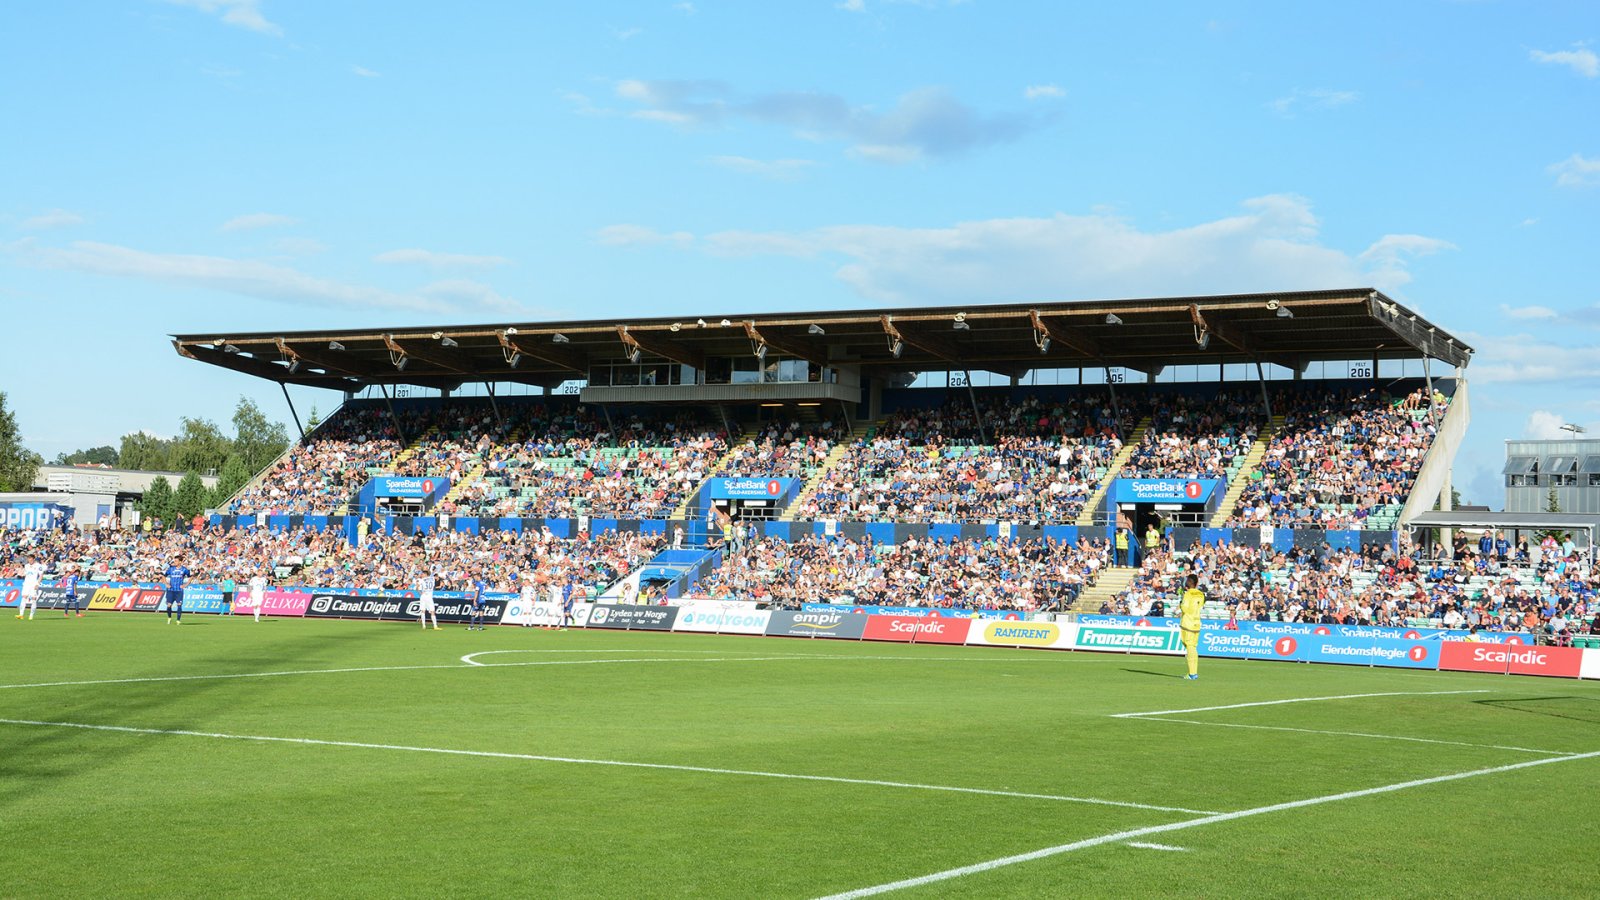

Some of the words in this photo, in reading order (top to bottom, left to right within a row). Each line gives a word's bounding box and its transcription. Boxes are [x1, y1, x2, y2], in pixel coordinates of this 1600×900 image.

[1350, 368, 1371, 378] 206
[951, 377, 967, 387] 204
[564, 386, 579, 394] 202
[386, 479, 421, 489] SpareBank
[724, 480, 766, 490] SpareBank
[1132, 481, 1184, 492] SpareBank
[95, 593, 117, 603] Uno
[264, 597, 306, 609] ELIXIA
[332, 600, 362, 612] Canal
[363, 602, 401, 614] Digital
[610, 610, 632, 618] Lyden
[644, 610, 667, 619] Norge
[696, 613, 766, 627] POLYGON
[793, 613, 841, 624] empir
[889, 620, 945, 633] Scandic
[994, 627, 1050, 639] RAMIRENT
[1082, 629, 1164, 647] Franzefoss
[1203, 632, 1273, 648] SpareBank
[1208, 646, 1272, 654] OSLO-AKERSHUS
[1321, 644, 1407, 659] EiendomsMegler
[1473, 648, 1547, 665] Scandic
